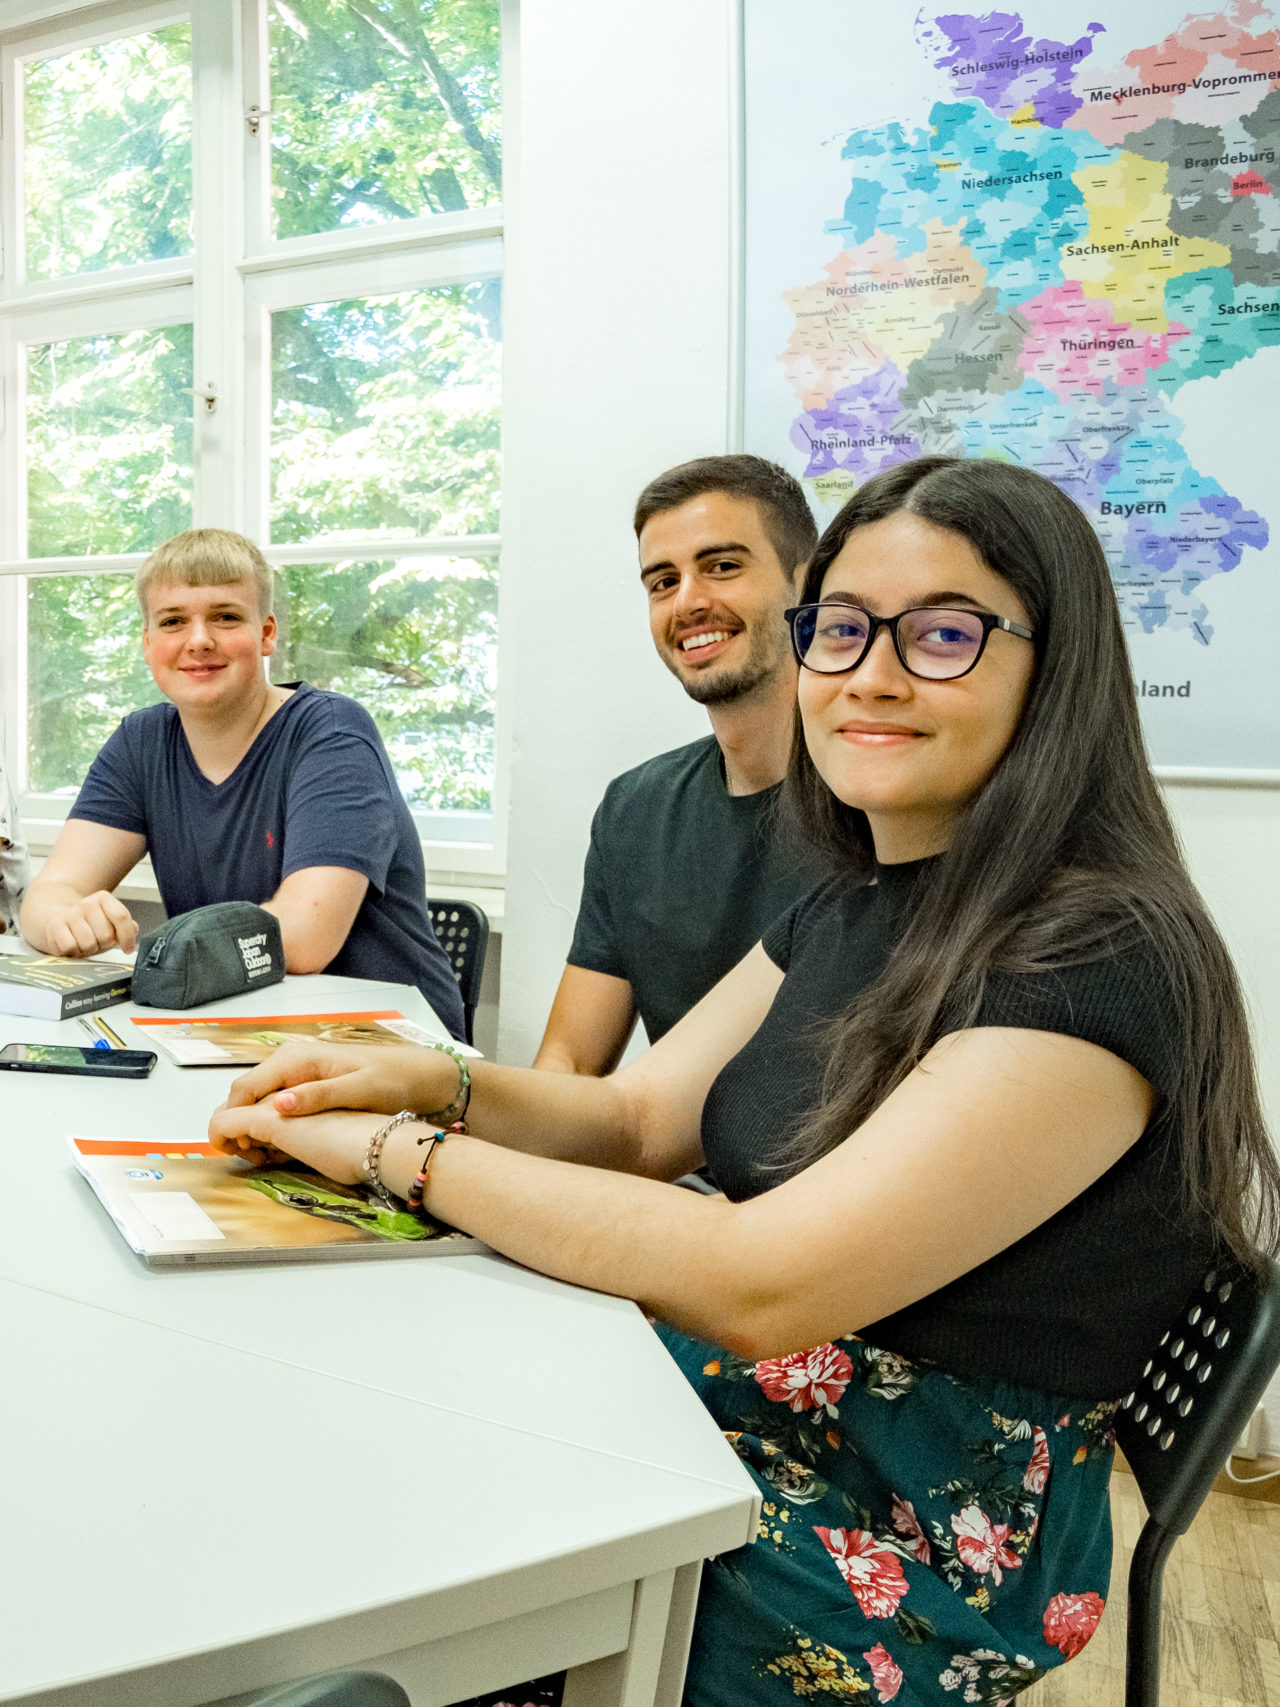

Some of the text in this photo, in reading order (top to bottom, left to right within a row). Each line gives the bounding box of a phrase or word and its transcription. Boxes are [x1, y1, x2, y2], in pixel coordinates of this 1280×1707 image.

[951, 49, 1083, 77] Schleswig-Holstein
[1184, 151, 1275, 169] Brandeburg
[961, 170, 1063, 190] Niedersachsen
[1232, 180, 1263, 190] Berlin
[1066, 235, 1180, 257] Sachsen-Anhalt
[826, 273, 970, 297] Norderhein-Westfalen
[1217, 302, 1280, 315] Sachsen
[1060, 337, 1134, 352] Thüringen
[954, 351, 1003, 364] Hessen
[811, 434, 913, 451] Rheinland-Pfalz
[815, 479, 853, 490] Saarland
[1135, 477, 1174, 487] Oberpfalz
[1100, 501, 1166, 518] Bayern
